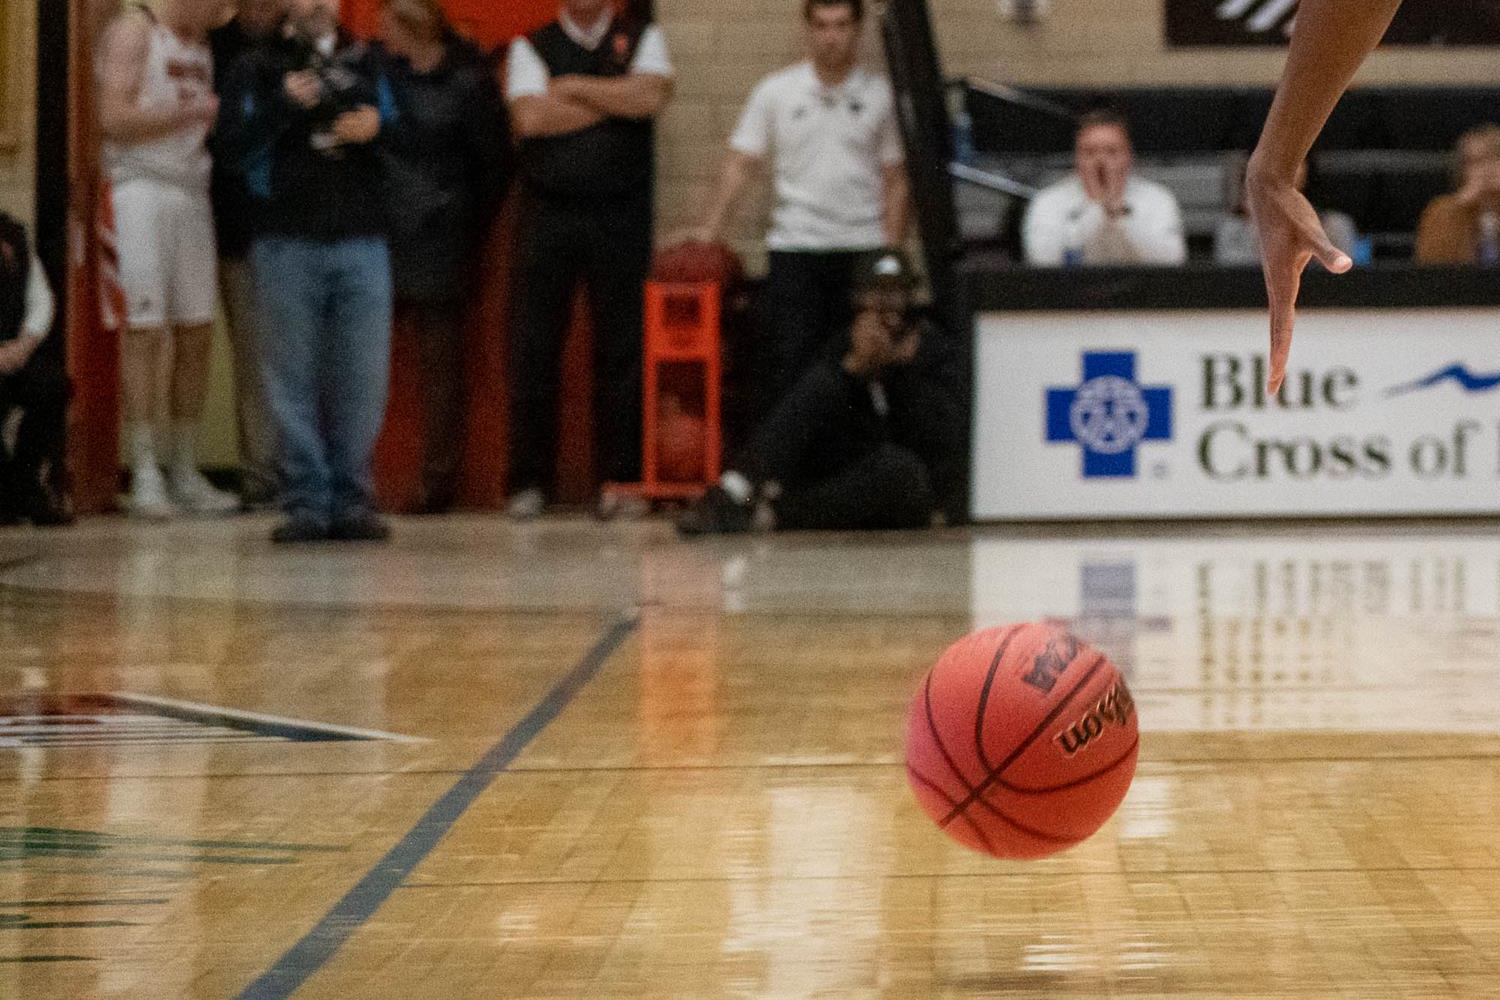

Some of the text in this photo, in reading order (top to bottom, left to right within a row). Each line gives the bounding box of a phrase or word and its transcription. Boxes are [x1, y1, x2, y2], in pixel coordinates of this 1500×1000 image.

[1199, 354, 1360, 411] Blue
[1198, 418, 1393, 481] Cross
[1407, 417, 1472, 479] of
